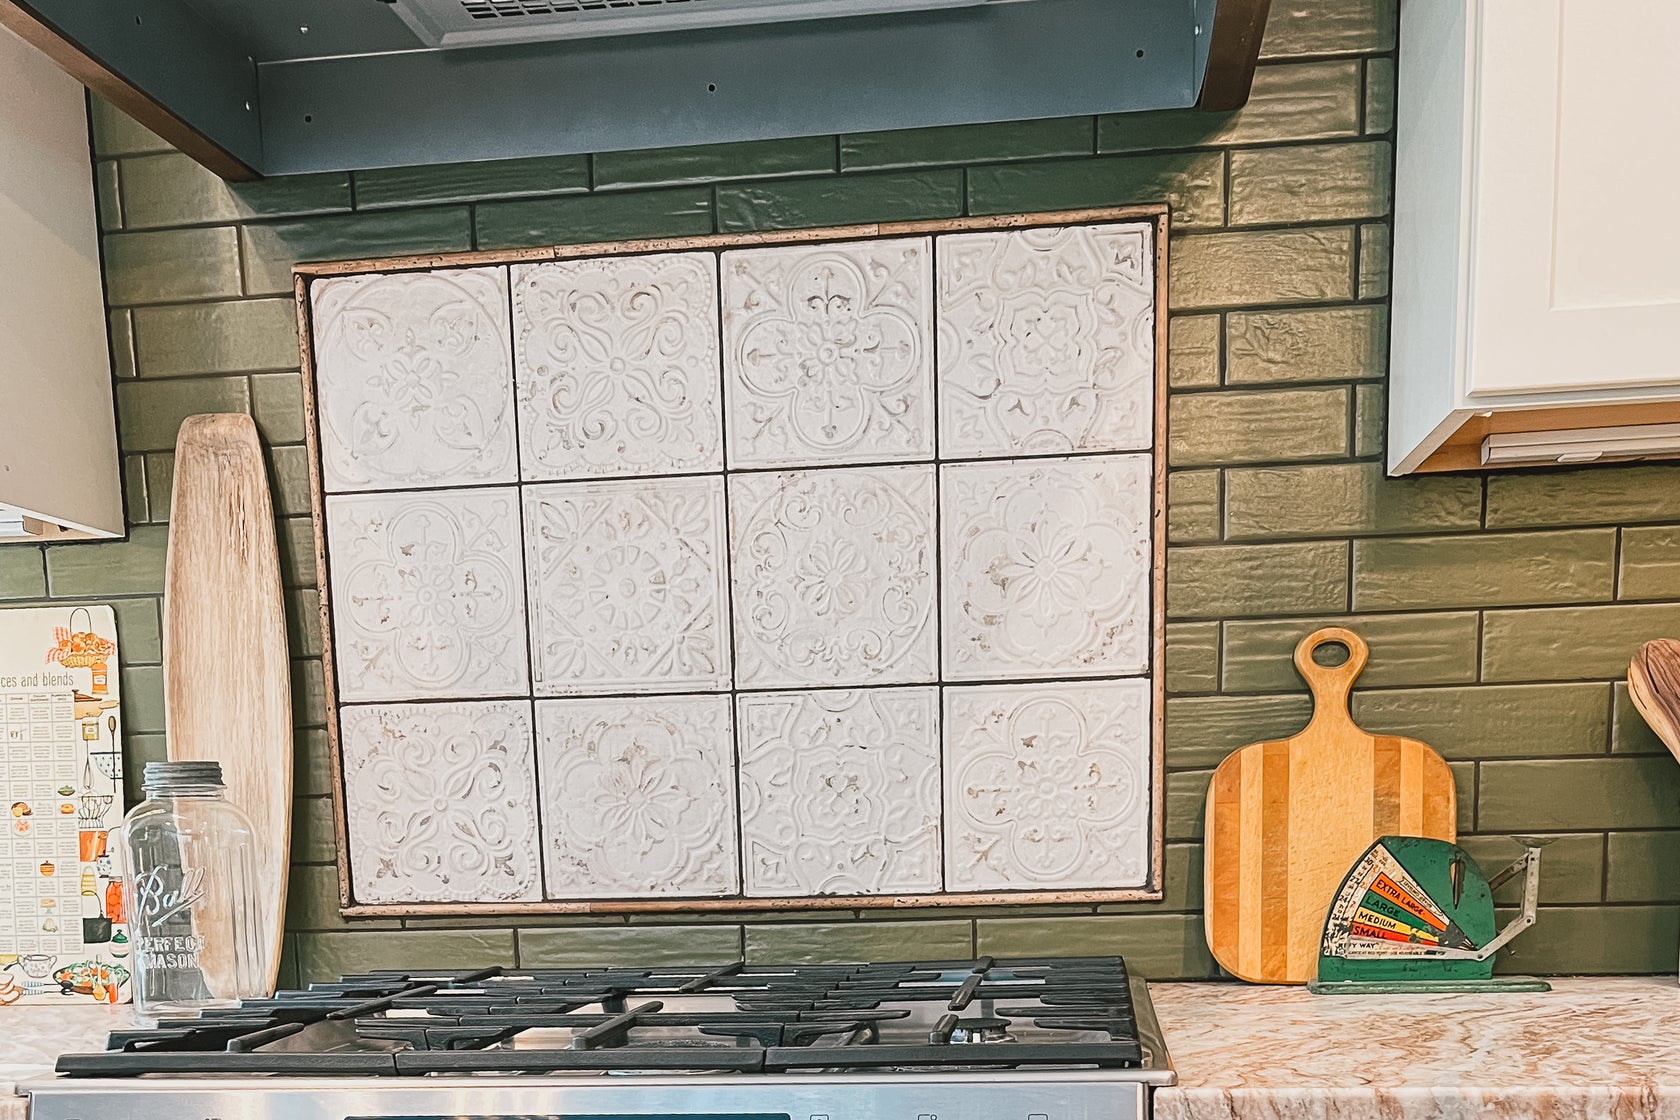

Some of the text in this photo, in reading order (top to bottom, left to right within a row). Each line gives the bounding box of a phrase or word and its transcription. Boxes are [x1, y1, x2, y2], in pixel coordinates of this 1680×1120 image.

[0, 672, 74, 688] ces and blends
[134, 864, 205, 927] Ball
[1375, 879, 1401, 900] EXTRA
[1401, 897, 1425, 916] LARGE
[1365, 895, 1400, 918] LARGE
[1358, 910, 1397, 930] MEDIUM
[1353, 925, 1388, 940] SMALL
[146, 952, 200, 969] MASON
